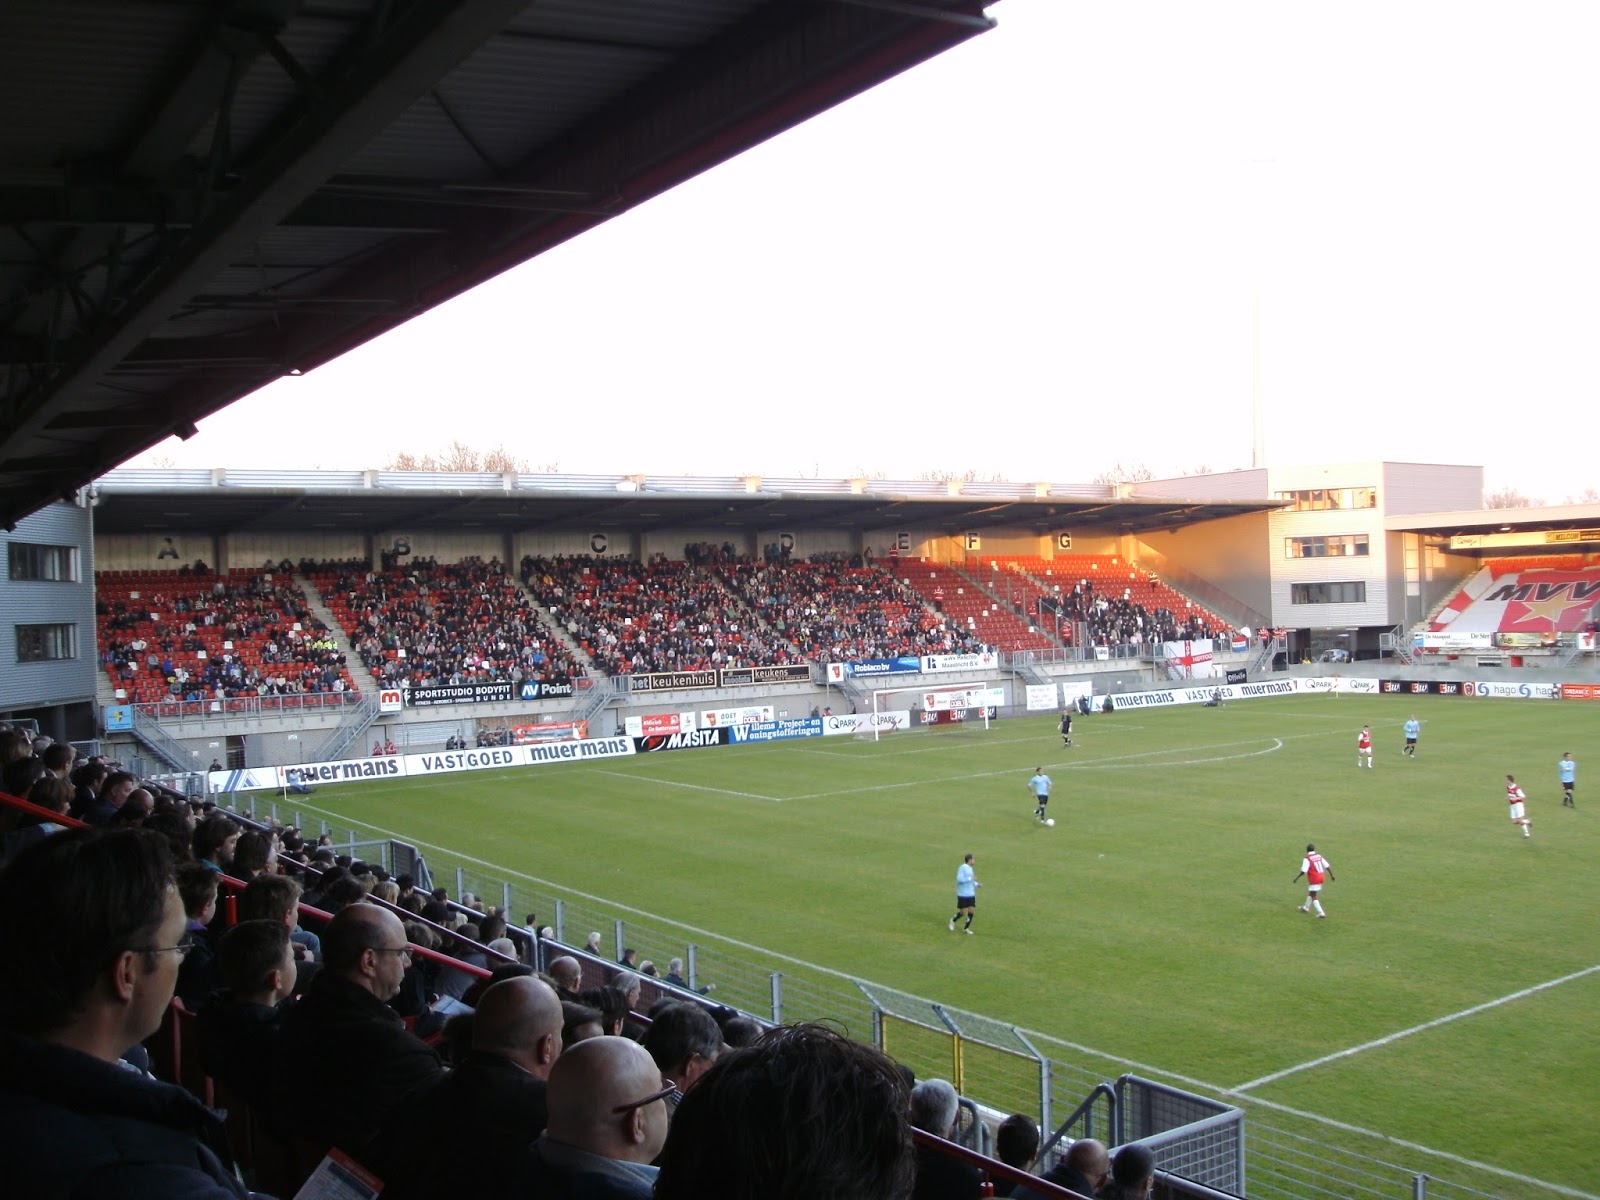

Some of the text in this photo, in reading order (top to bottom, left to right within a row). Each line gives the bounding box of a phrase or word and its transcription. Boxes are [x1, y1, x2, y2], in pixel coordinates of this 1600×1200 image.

[157, 536, 179, 560] A
[394, 536, 411, 556] B
[590, 533, 607, 554] C
[780, 533, 794, 551] D
[897, 533, 909, 550] E
[968, 532, 978, 549] F
[1059, 533, 1071, 549] G
[1484, 580, 1600, 602] MVV
[754, 668, 789, 678] keukens
[941, 661, 969, 669] Maastricht
[521, 683, 571, 697] AV Point
[631, 674, 714, 691] het keukenhuis
[1494, 685, 1517, 696] hago
[414, 684, 511, 699] SPORTSTUDIO BODYFIT
[1115, 681, 1292, 707] muermans VASTGED muermans
[1535, 686, 1556, 697] hag
[666, 729, 720, 749] MASITA
[421, 750, 513, 771] VASTGOED
[531, 739, 628, 761] muermans
